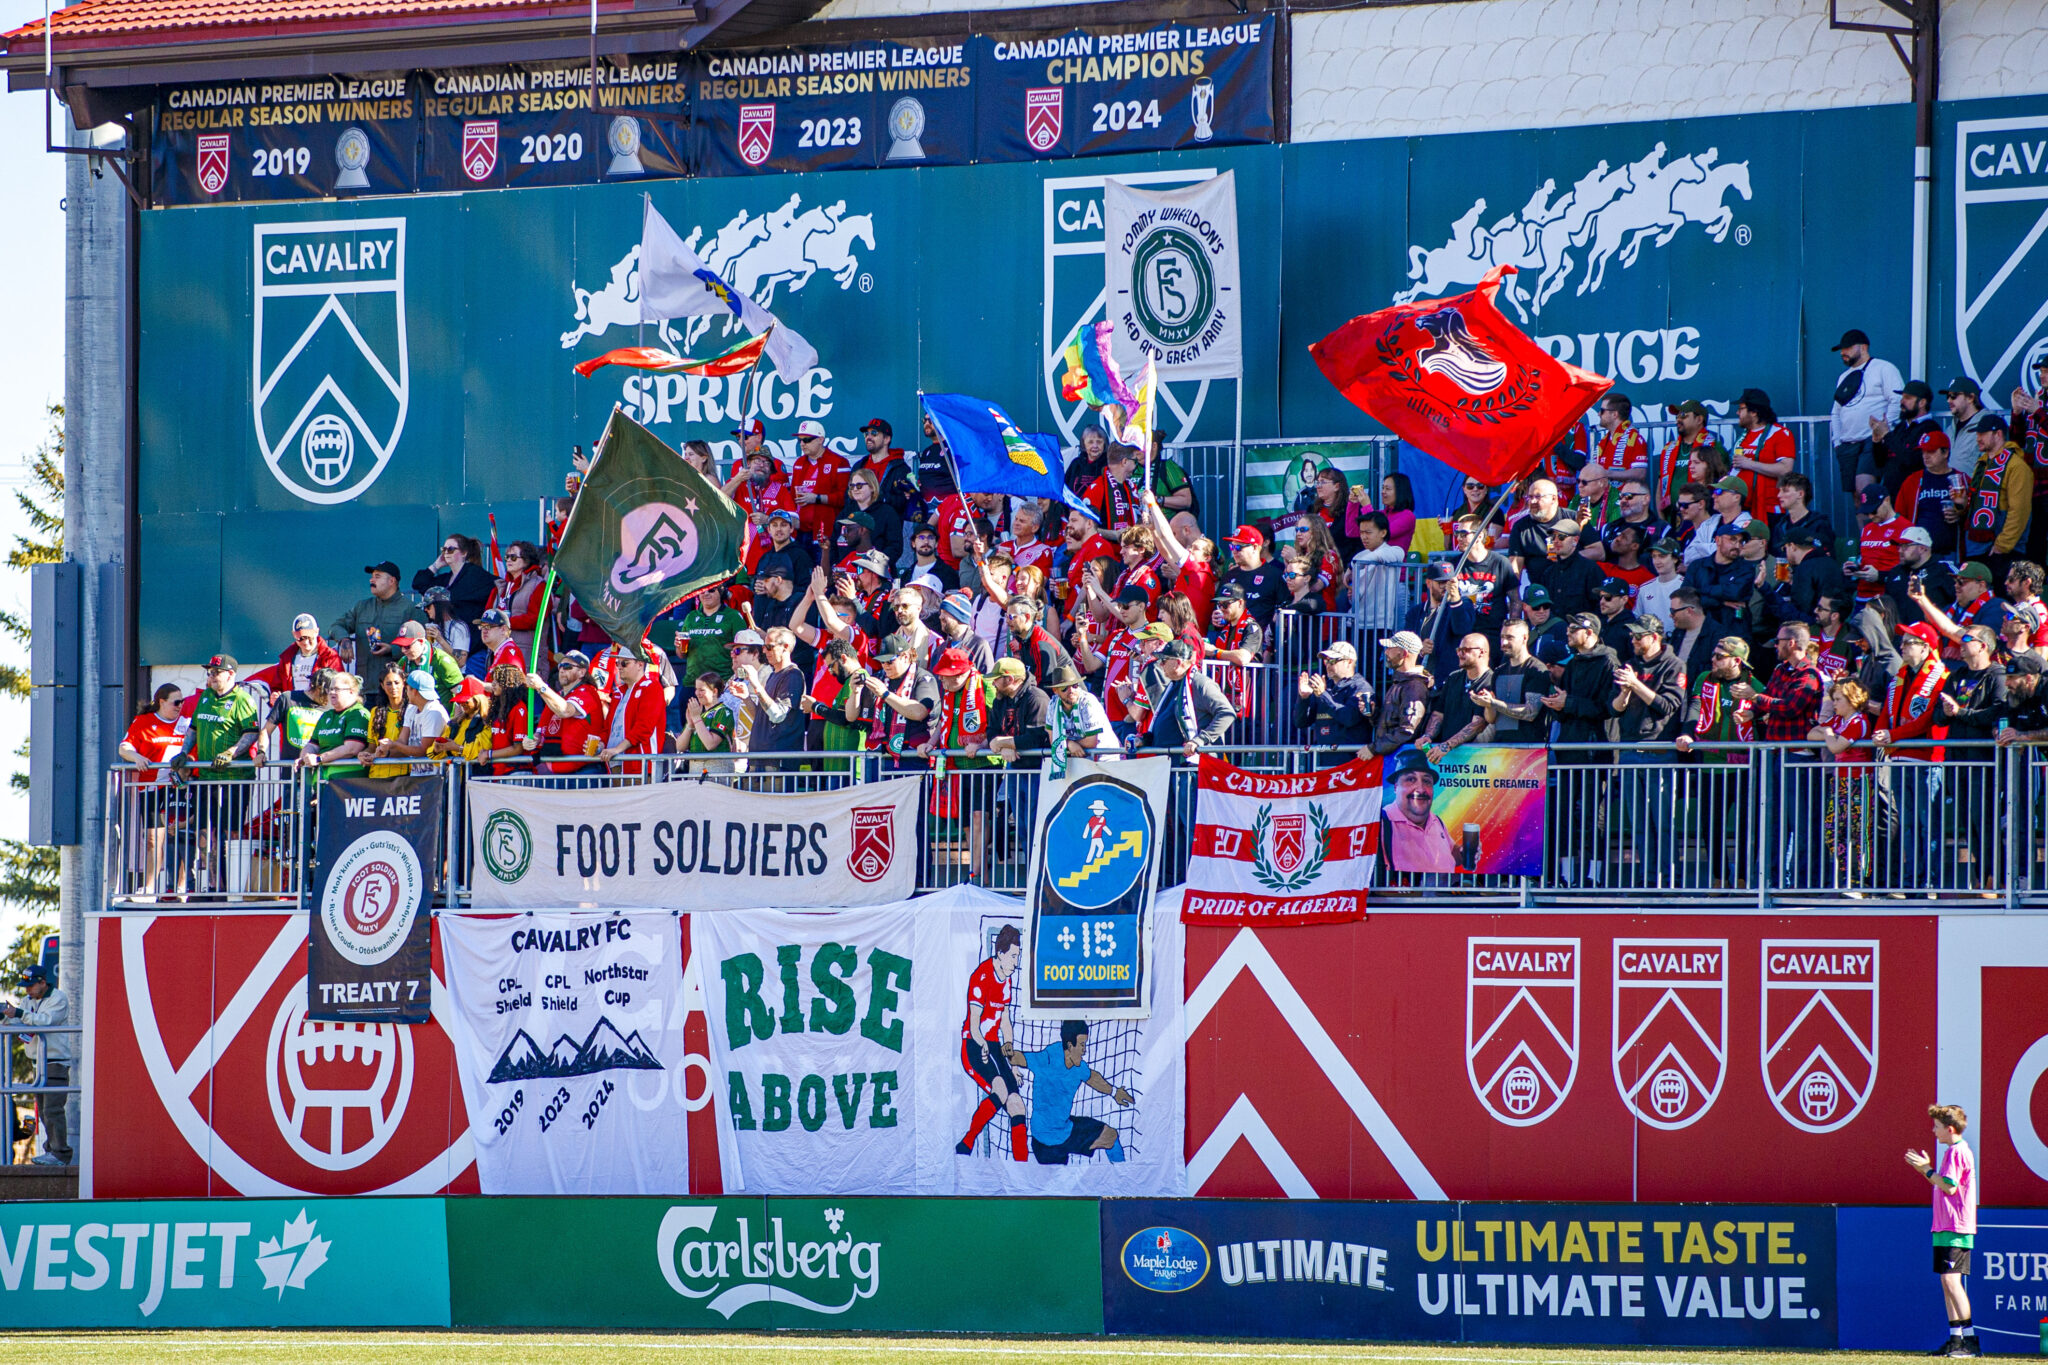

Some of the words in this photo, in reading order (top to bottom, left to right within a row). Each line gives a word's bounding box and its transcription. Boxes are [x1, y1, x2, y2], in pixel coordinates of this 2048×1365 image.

[993, 36, 1093, 61] CANADIAN
[1098, 30, 1180, 54] PREMIER
[1185, 23, 1261, 48] LEAGUE
[708, 55, 803, 78] CANADIAN
[809, 50, 887, 72] PREMIER
[891, 45, 963, 67] LEAGUE
[1046, 49, 1205, 85] CHAMPIONS
[168, 86, 256, 109] CANADIAN
[261, 82, 334, 104] PREMIER
[339, 79, 406, 99] LEAGUE
[434, 72, 525, 95] CANADIAN
[531, 67, 605, 90] PREMIER
[609, 63, 678, 84] LEAGUE
[700, 78, 791, 100] REGULAR
[796, 72, 874, 96] SEASON
[878, 67, 971, 91] WINNERS
[424, 95, 513, 118] REGULAR
[518, 89, 592, 112] SEASON
[598, 83, 686, 107] WINNERS
[1029, 92, 1060, 103] CAVALRY
[161, 110, 244, 132] REGULAR
[249, 104, 322, 126] SEASON
[326, 99, 413, 122] WINNERS
[743, 108, 772, 119] CAVALRY
[1092, 99, 1162, 132] 2024
[200, 138, 227, 149] CAVALRY
[466, 125, 495, 136] CAVALRY
[798, 117, 862, 148] 2023
[252, 147, 311, 177] 2019
[519, 132, 583, 164] 2020
[1121, 209, 1156, 256] TOMMY
[1159, 207, 1224, 255] WHEELDON'S
[266, 239, 394, 275] CAVALRY
[1122, 312, 1140, 342] RED
[1139, 339, 1164, 362] AND
[1166, 343, 1201, 365] GREEN
[1201, 308, 1227, 351] ARMY
[1158, 325, 1191, 339] MMXV
[621, 367, 834, 424] SPRUCE
[1973, 490, 1999, 529] FC
[689, 628, 715, 636] WESTJET
[1225, 770, 1318, 795] CAVALRY
[1328, 768, 1357, 790] FC
[1438, 763, 1470, 775] THATS
[1471, 764, 1488, 775] AN
[1439, 777, 1491, 789] ABSOLUTE
[1493, 778, 1540, 790] CREAMER
[344, 797, 376, 818] WE
[381, 795, 421, 817] ARE
[1276, 819, 1302, 828] CAVALRY
[556, 822, 642, 877] FOOT
[653, 818, 828, 877] SOLDIERS
[1214, 827, 1243, 857] 20
[1348, 826, 1368, 858] 19
[351, 866, 370, 888] FOOT
[371, 863, 398, 886] SOLDIERS
[497, 869, 518, 881] MMXV
[398, 895, 415, 928] Calgary
[1187, 896, 1246, 916] PRIDE
[1248, 896, 1274, 916] OF
[1274, 896, 1358, 916] ALBERTA
[337, 931, 355, 951] Coude
[355, 922, 379, 933] MMXV
[511, 923, 602, 953] CAVALRY
[605, 918, 632, 943] FC
[584, 962, 649, 986] Northstar
[1044, 965, 1076, 981] FOOT
[1077, 964, 1130, 981] SOLDIERS
[1475, 950, 1572, 972] CAVALRY
[1620, 952, 1720, 974] CAVALRY
[1769, 953, 1871, 976] CAVALRY
[319, 981, 401, 1005] TREATY
[406, 979, 419, 1001] 7
[498, 977, 523, 994] CPL
[545, 975, 571, 990] CPL
[720, 941, 913, 1054] RISE
[496, 992, 532, 1015] Shield
[541, 996, 578, 1011] Shield
[604, 990, 631, 1007] Cup
[494, 1088, 525, 1136] 2019
[538, 1086, 571, 1133] 2023
[582, 1079, 615, 1130] 2024
[728, 1070, 899, 1132] ABOVE
[1416, 1220, 1644, 1263] ULTIMATE
[1653, 1220, 1808, 1265] TASTE.
[657, 1206, 882, 1318] Carlsberg
[1132, 1253, 1165, 1269] Maple
[1165, 1254, 1198, 1271] Lodge
[1154, 1268, 1177, 1279] FARMS
[1217, 1239, 1389, 1291] ULTIMATE
[1417, 1273, 1645, 1317] ULTIMATE
[1655, 1275, 1821, 1320] VALUE.
[1995, 1294, 2048, 1311] FARM
